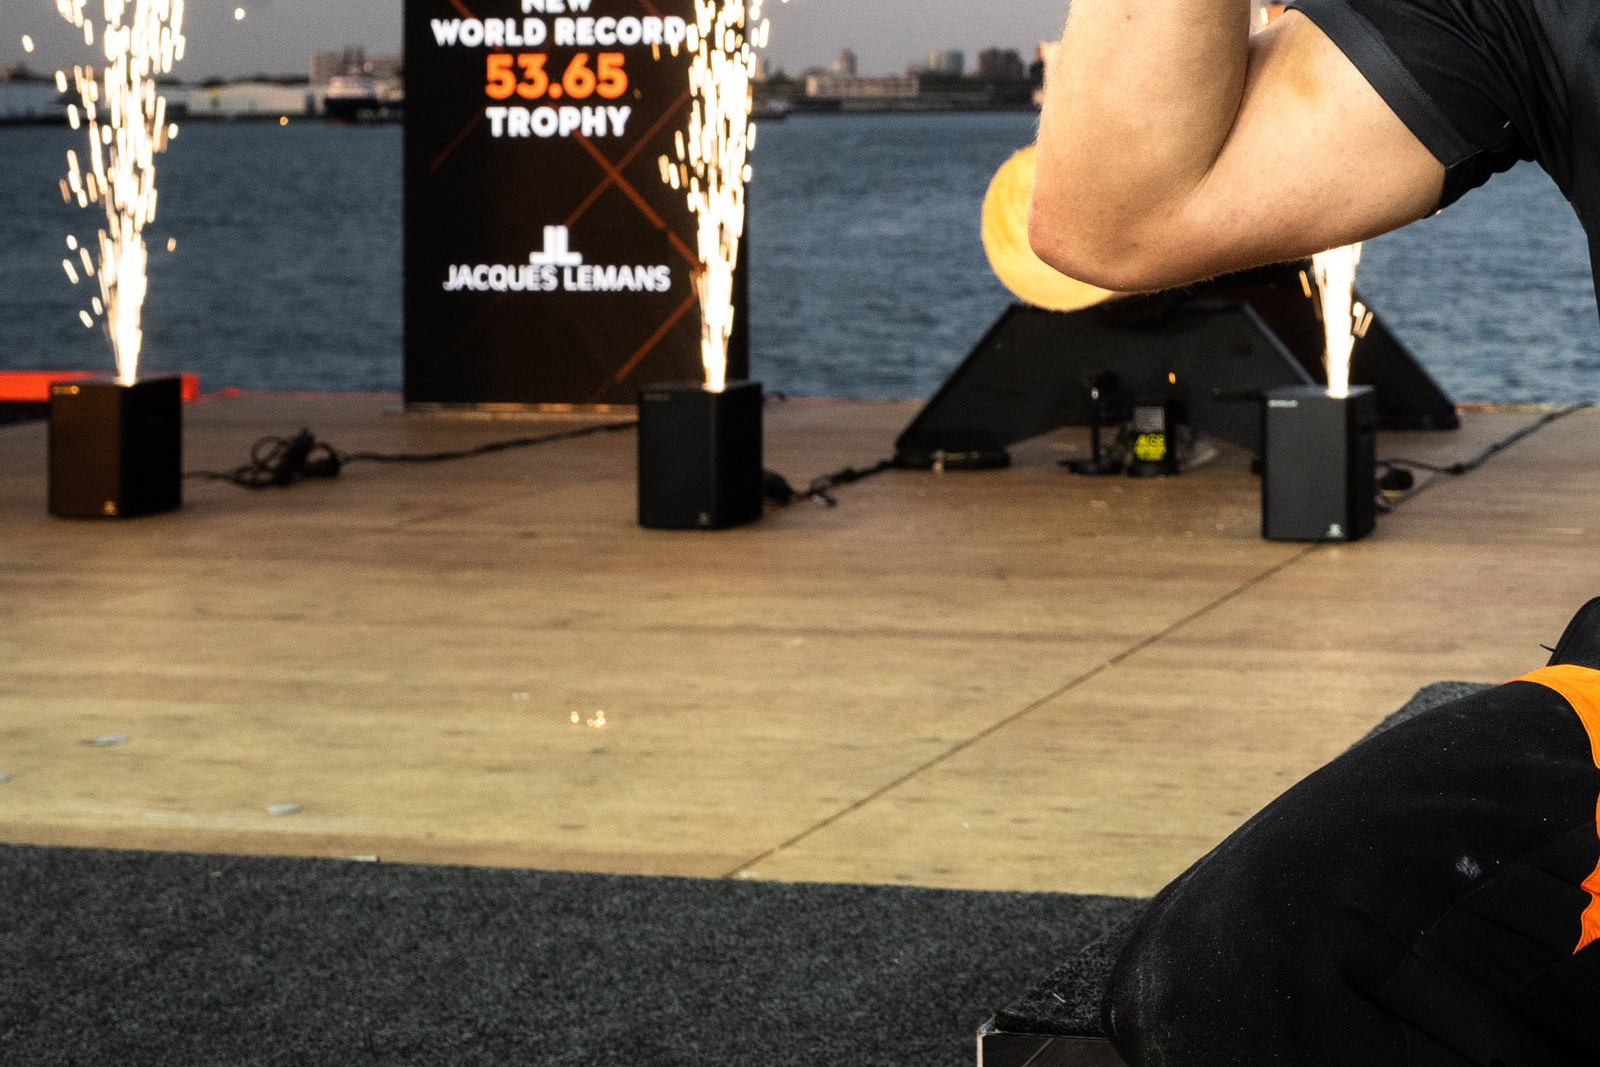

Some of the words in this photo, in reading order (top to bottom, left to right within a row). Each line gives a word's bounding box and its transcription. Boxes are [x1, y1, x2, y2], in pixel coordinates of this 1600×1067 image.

[431, 17, 547, 47] WORLD
[554, 16, 687, 47] RECORD
[485, 52, 628, 100] 53.65
[485, 106, 631, 137] TROPHY
[443, 264, 558, 292] JACQUES
[563, 264, 671, 292] LEMANS
